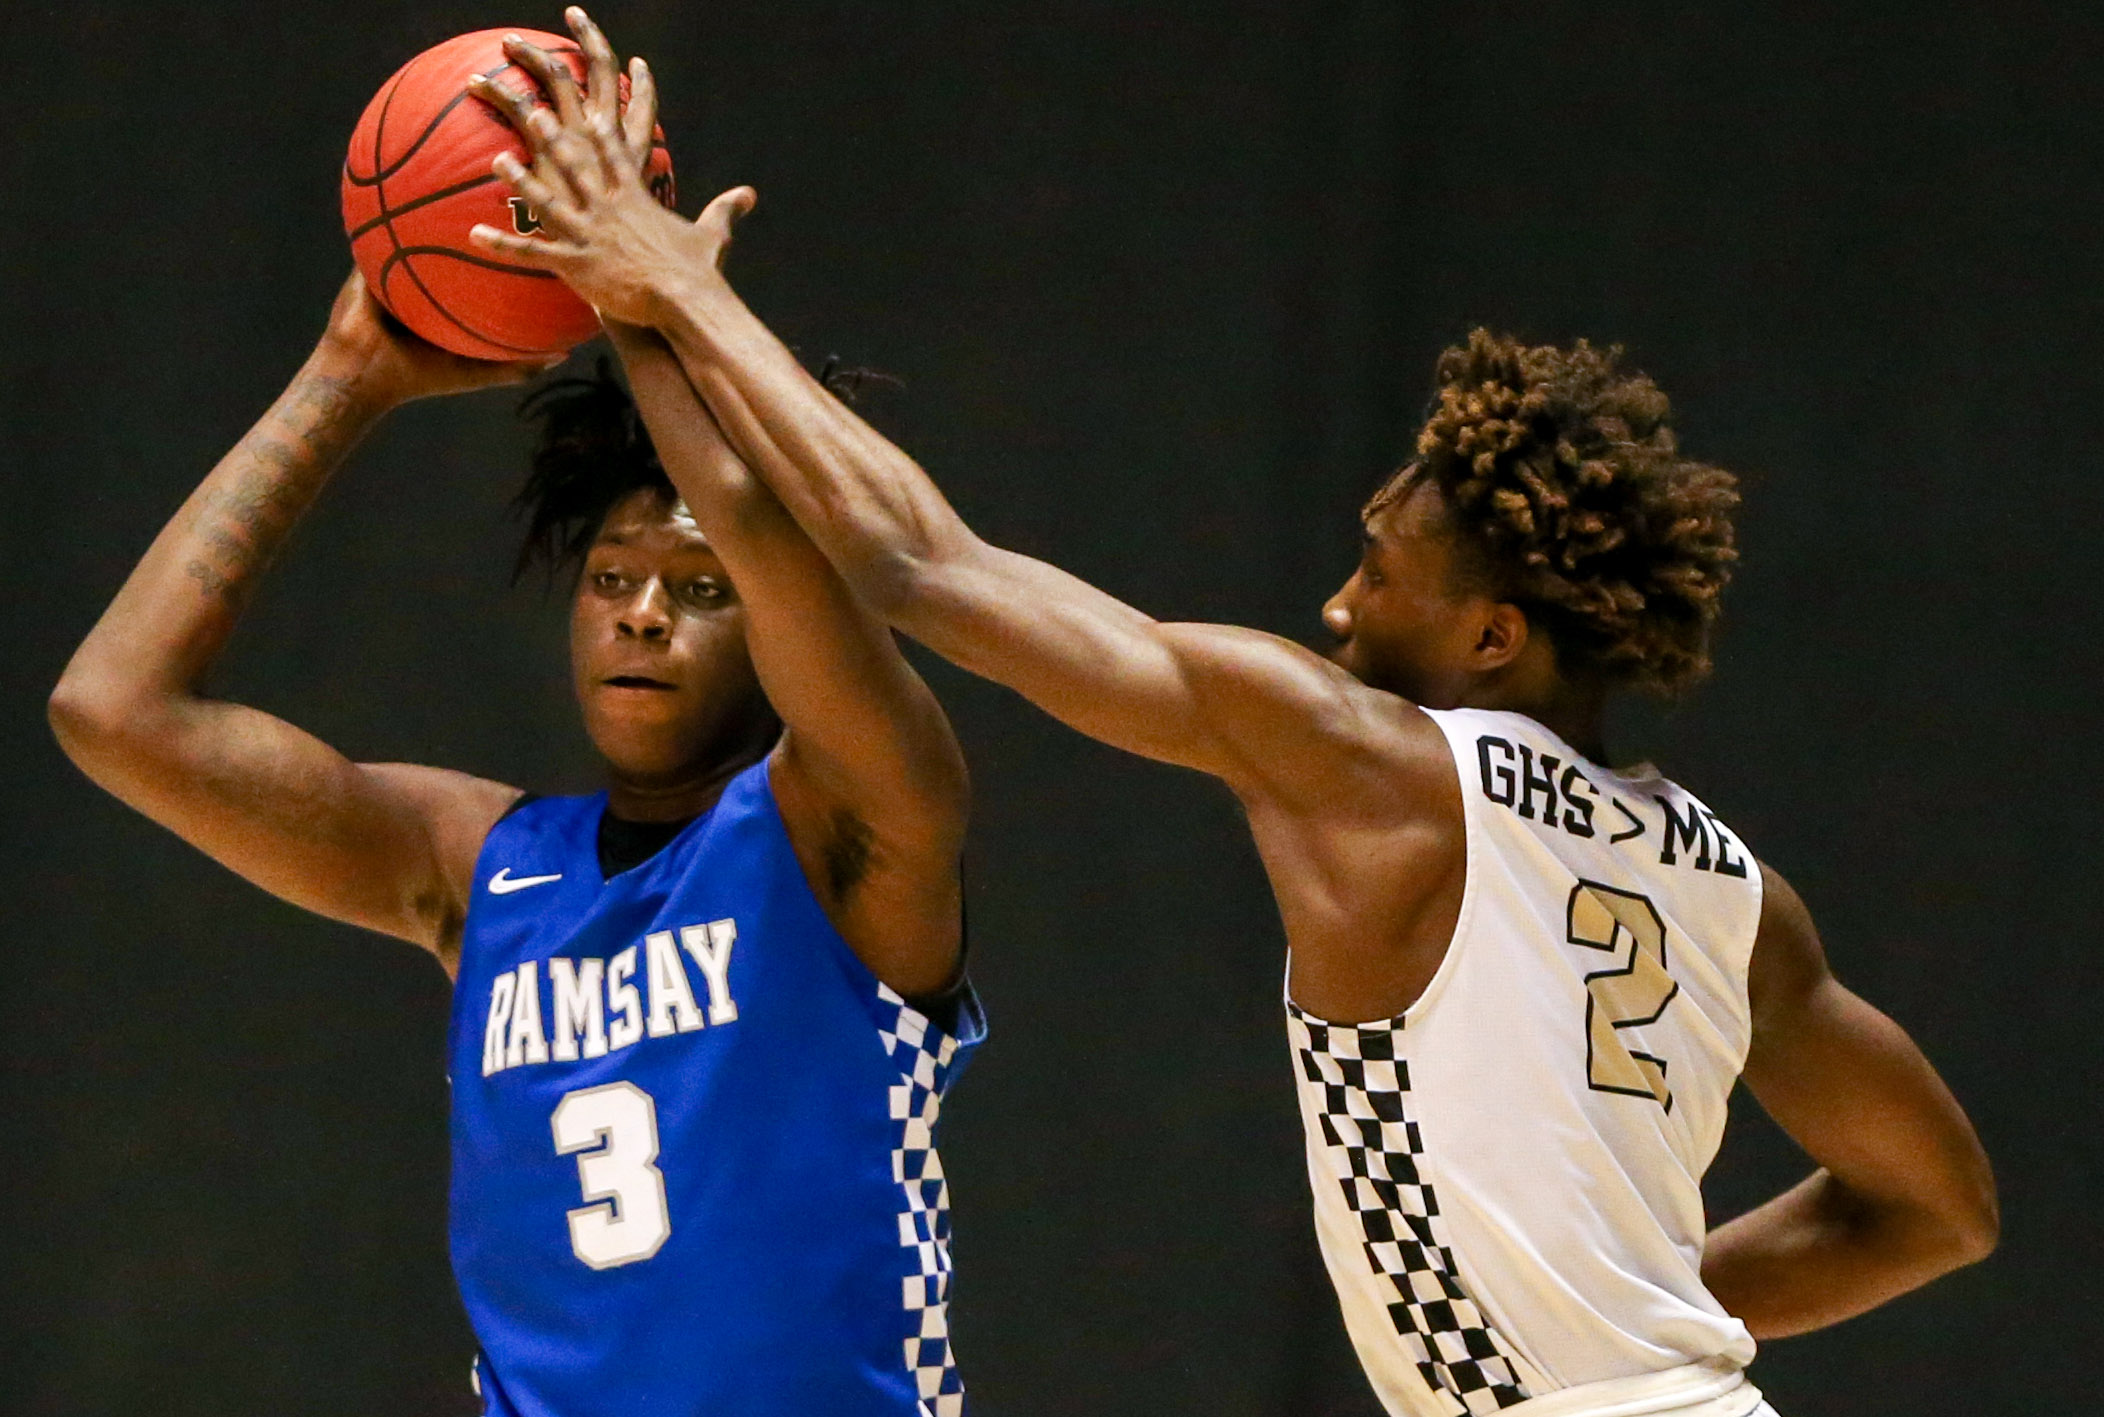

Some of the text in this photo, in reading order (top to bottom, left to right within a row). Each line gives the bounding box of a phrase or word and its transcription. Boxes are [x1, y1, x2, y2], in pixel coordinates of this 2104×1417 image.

[1476, 735, 1600, 840] GHS
[482, 918, 739, 1078] RAMSAY
[1566, 877, 1679, 1116] 2
[550, 1080, 672, 1271] 3
